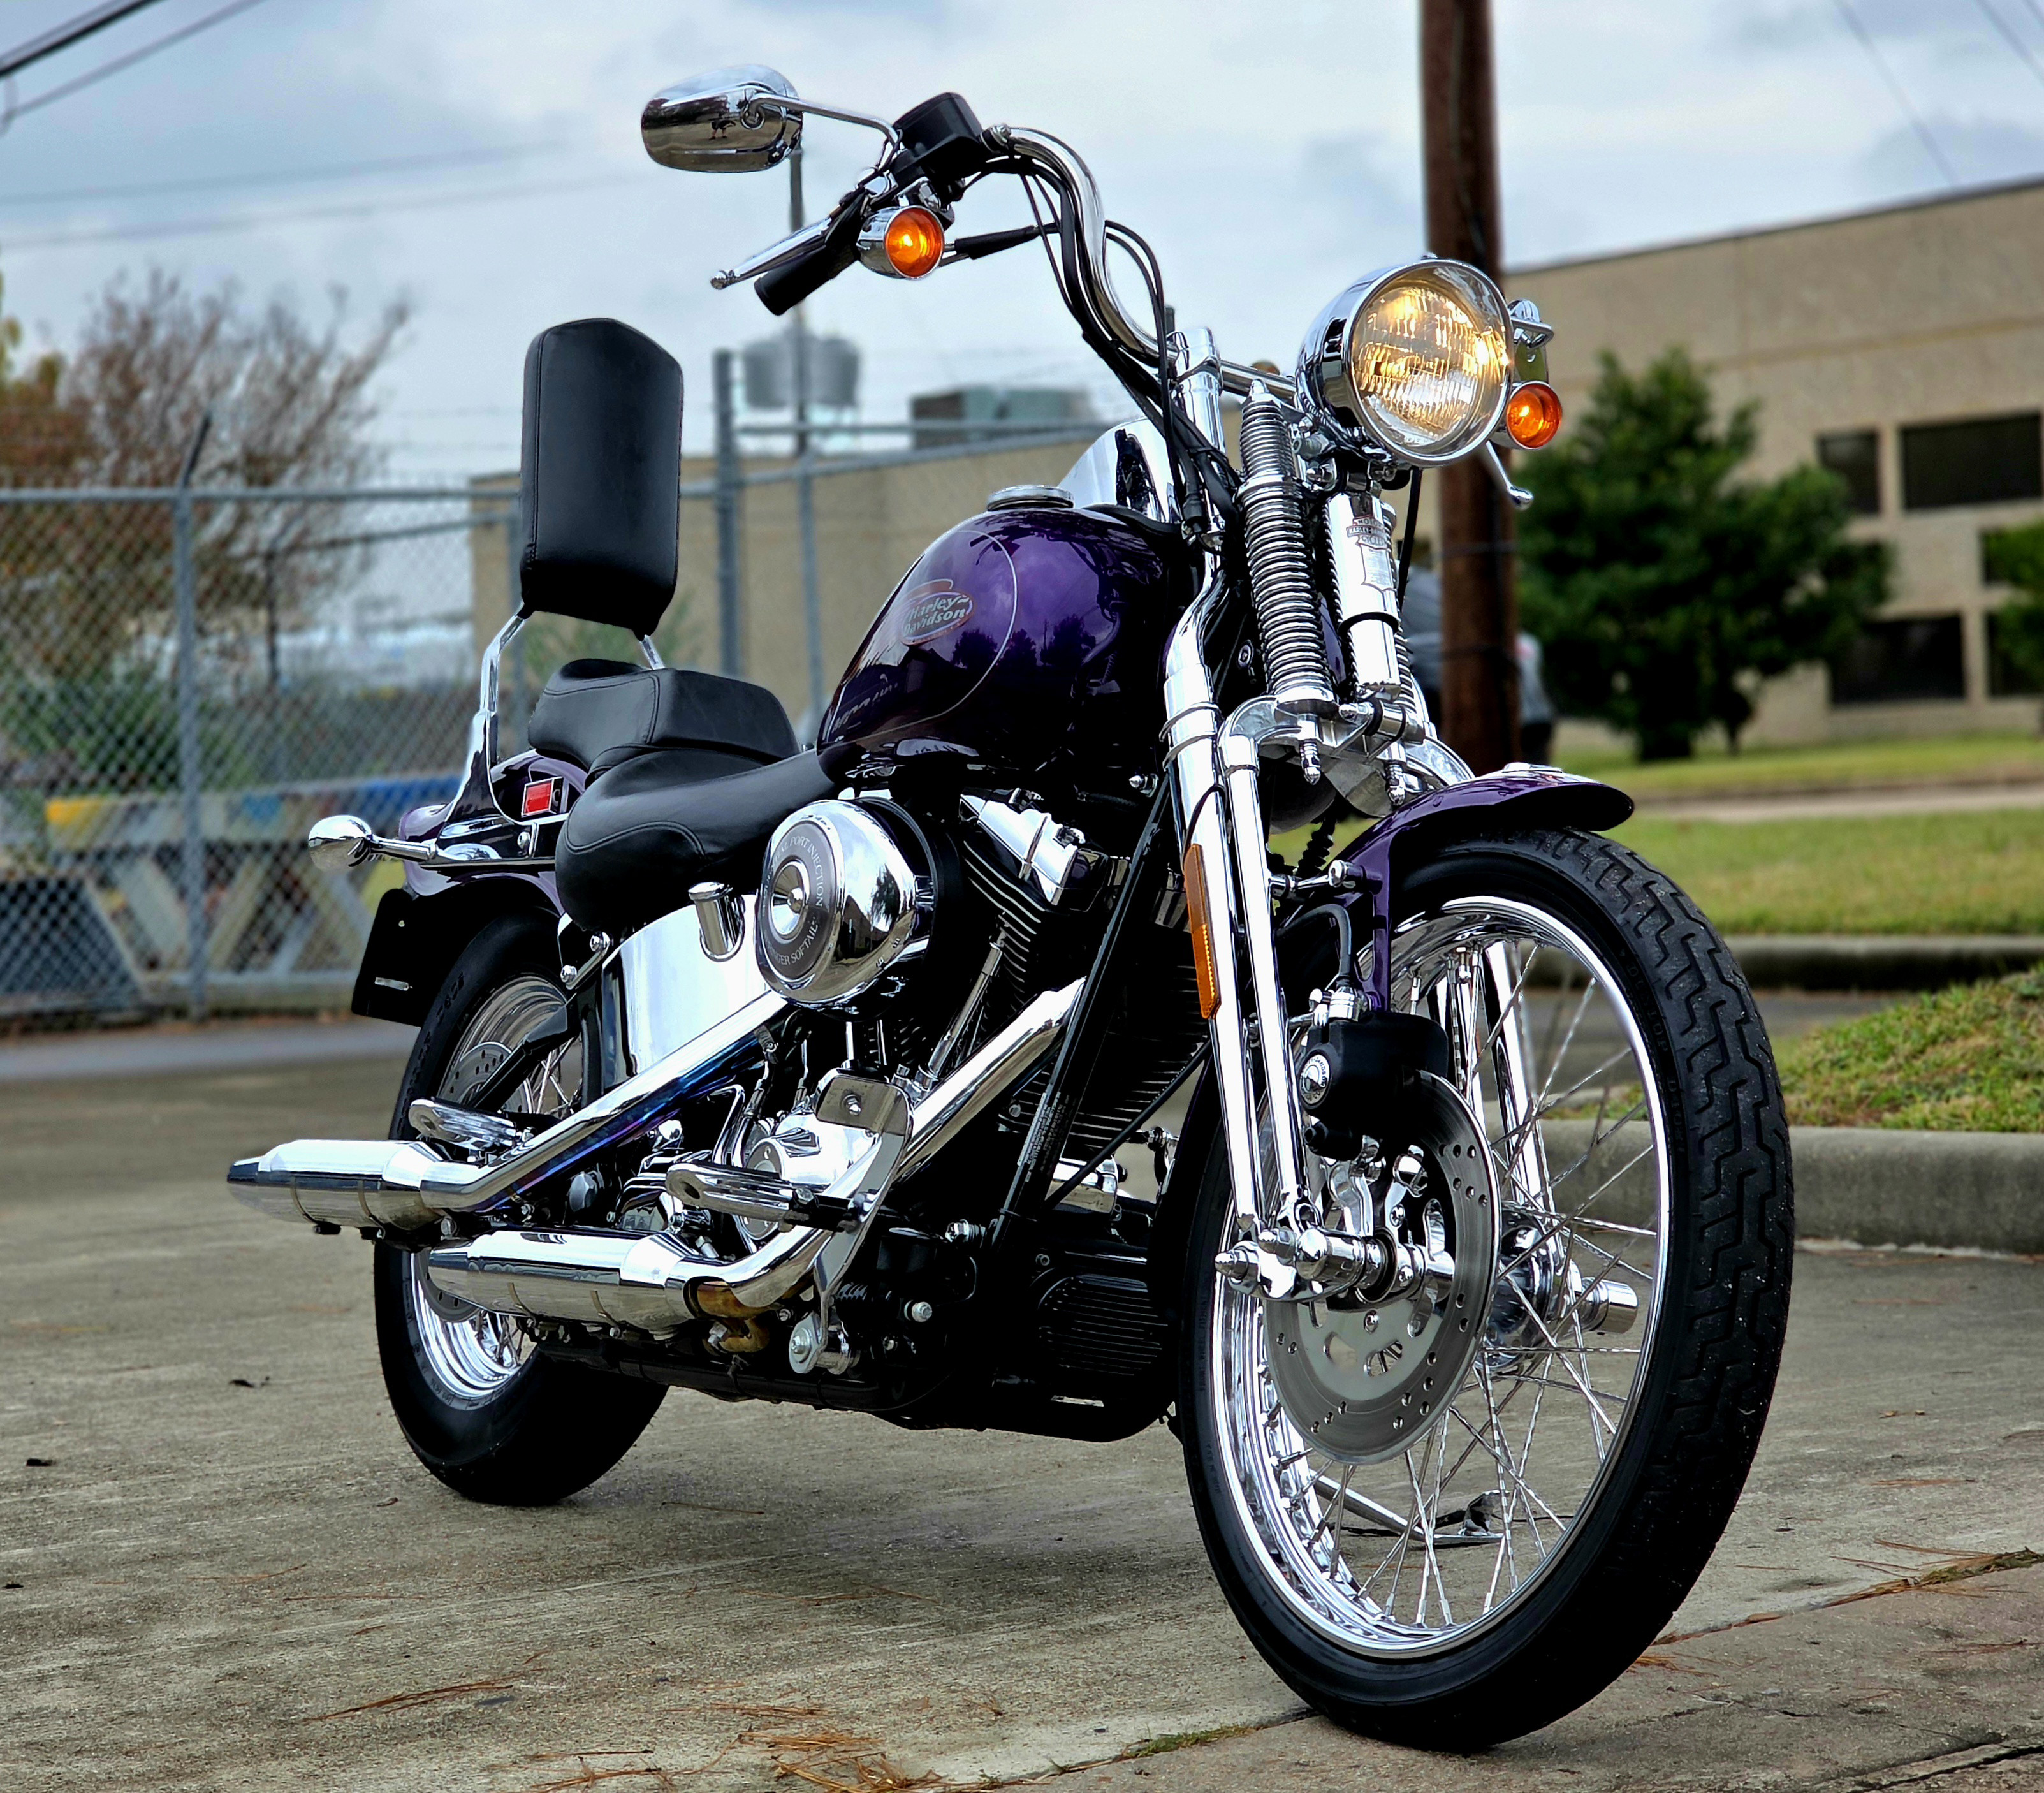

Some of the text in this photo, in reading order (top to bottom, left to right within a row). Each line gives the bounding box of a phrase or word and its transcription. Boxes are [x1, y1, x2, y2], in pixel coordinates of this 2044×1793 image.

[903, 608, 966, 636] Davidson
[790, 835, 824, 907] PORT INJECTION
[791, 924, 819, 963] SOFTAIL
